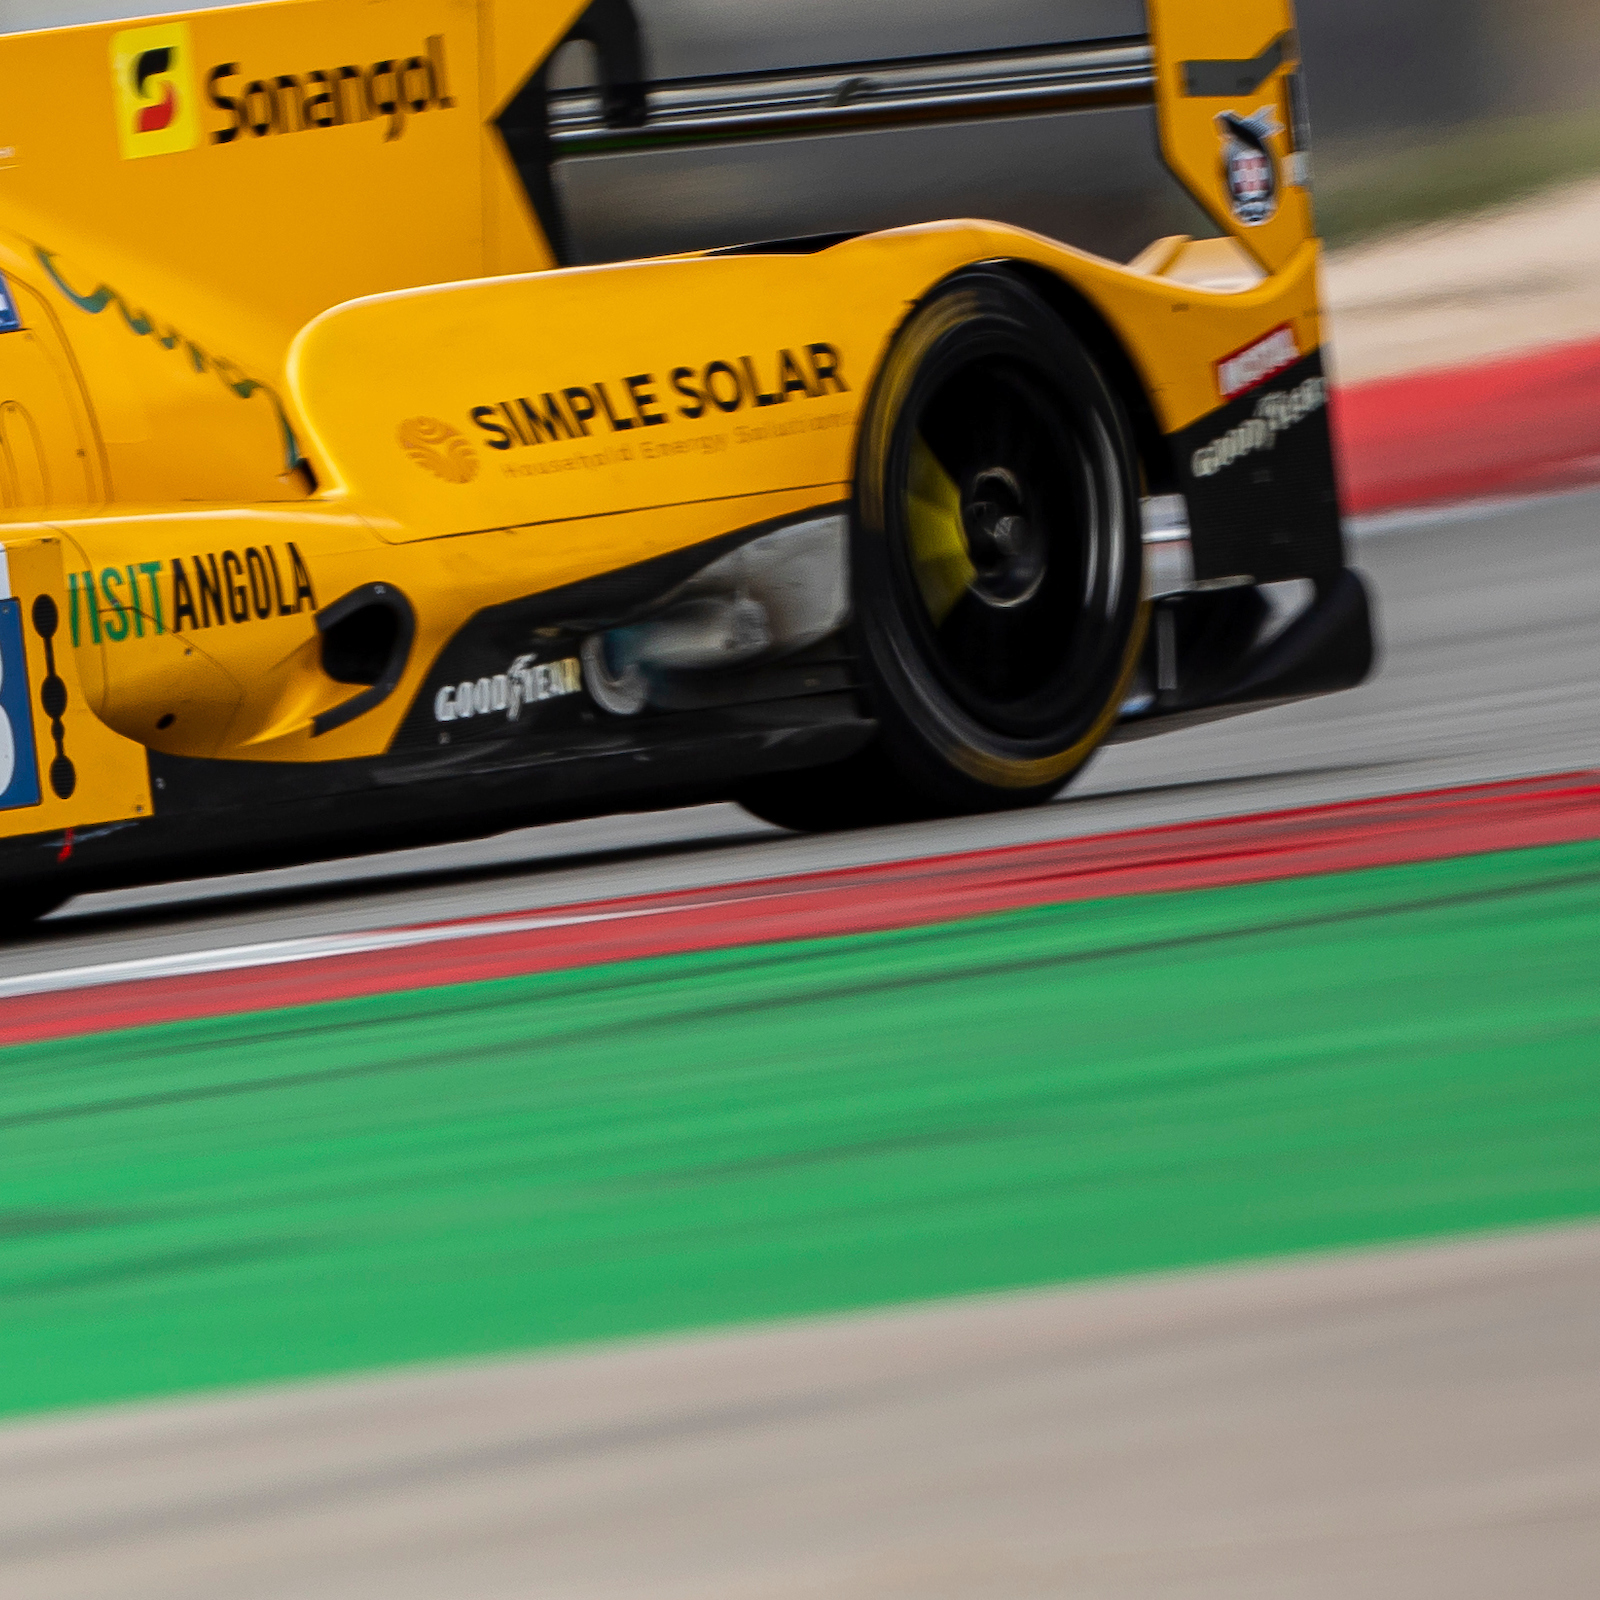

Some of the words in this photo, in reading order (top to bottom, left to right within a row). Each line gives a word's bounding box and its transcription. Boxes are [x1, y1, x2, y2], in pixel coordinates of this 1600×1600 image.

[204, 33, 457, 145] Sonangol
[469, 372, 669, 451] SIMPLE
[668, 341, 852, 420] SOLAR
